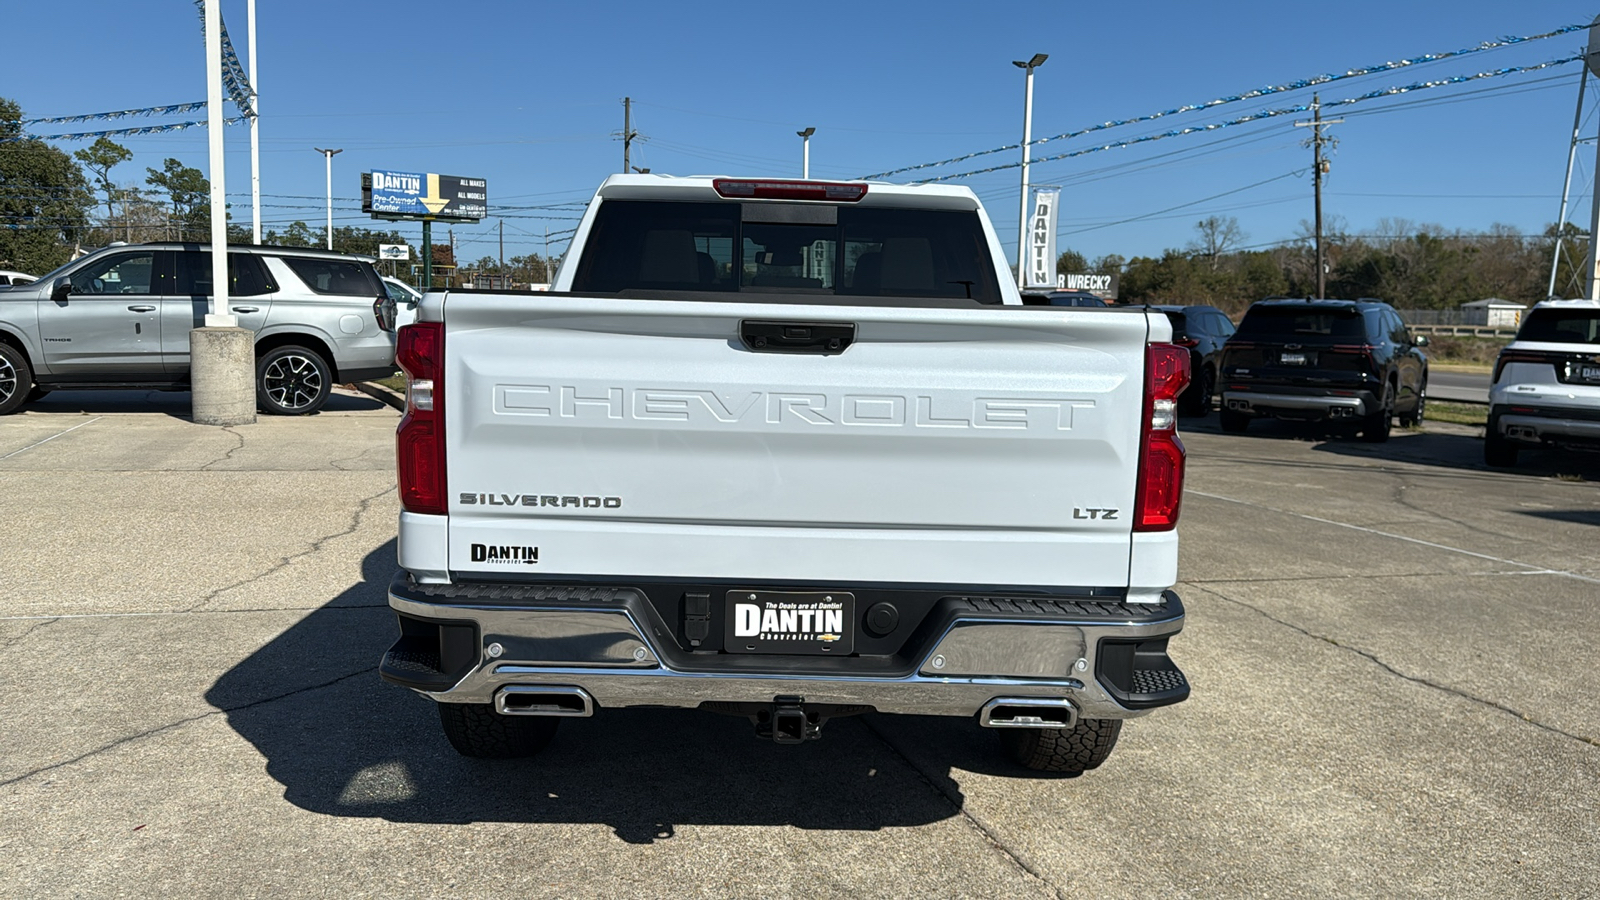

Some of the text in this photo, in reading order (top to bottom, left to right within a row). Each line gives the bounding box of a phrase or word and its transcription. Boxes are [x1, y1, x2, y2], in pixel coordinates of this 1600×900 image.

[372, 172, 420, 190] DANTIN
[460, 179, 485, 188] ALL MAKES
[373, 194, 417, 206] Pre-Owned
[457, 191, 485, 200] ALL MODELS
[373, 202, 400, 211] Center
[1034, 204, 1048, 284] DANTIN
[1067, 274, 1111, 289] WRECK?
[492, 384, 1096, 431] CHEVROLET
[459, 492, 622, 508] SILVERADO
[1073, 507, 1119, 520] LTZ
[471, 543, 538, 562] DANTIN
[778, 602, 797, 610] Deals
[818, 602, 843, 610] Dantin!
[735, 603, 843, 637] DANTIN
[760, 633, 814, 641] Chevrolet
